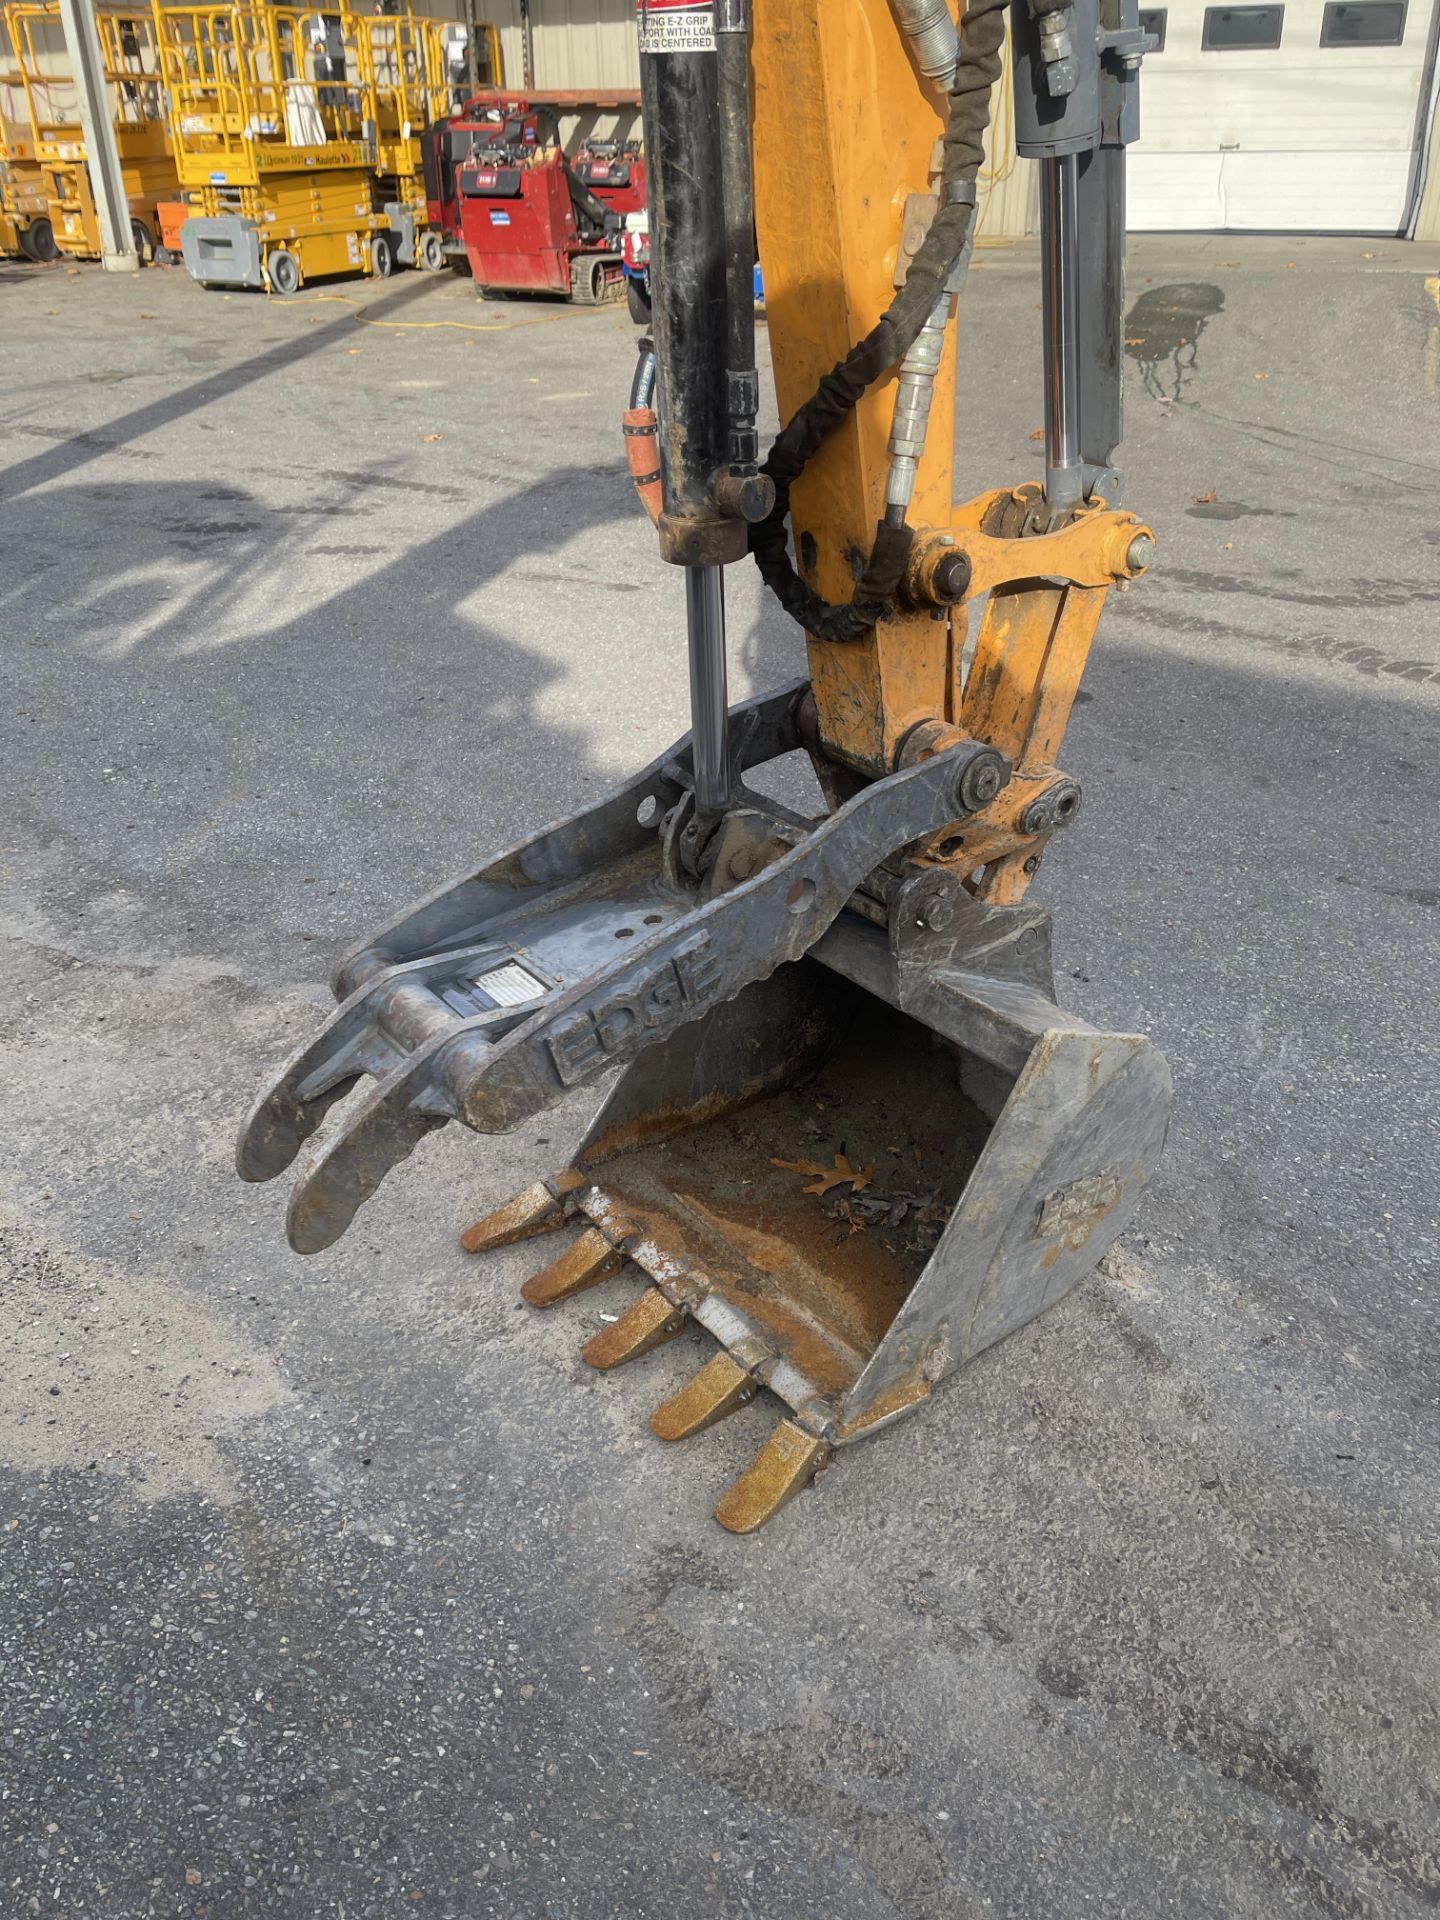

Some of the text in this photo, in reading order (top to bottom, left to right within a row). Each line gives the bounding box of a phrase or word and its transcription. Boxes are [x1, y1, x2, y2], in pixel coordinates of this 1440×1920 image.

[667, 16, 683, 26] E-Z
[685, 15, 708, 25] GRIP
[666, 28, 691, 37] WITH
[651, 39, 659, 48] IS
[661, 37, 712, 48] CENTERED
[546, 928, 724, 1088] EDGE
